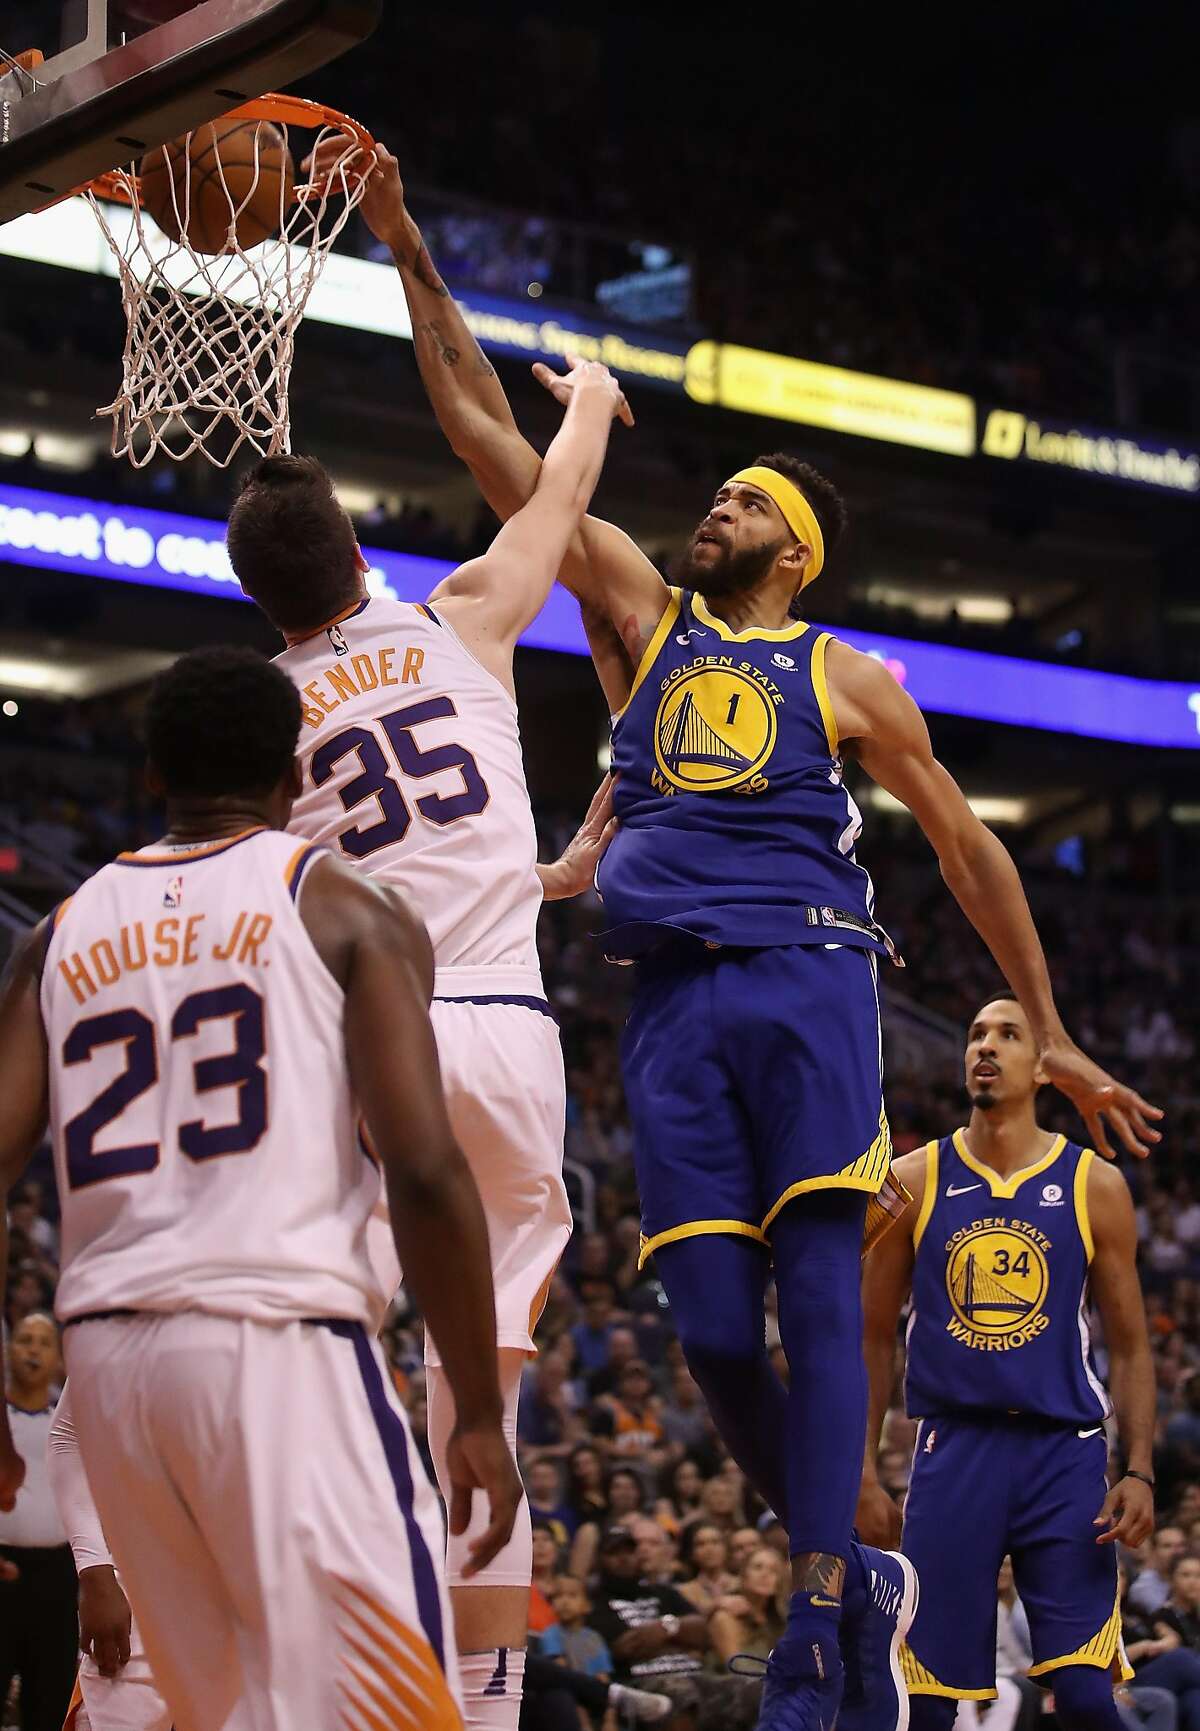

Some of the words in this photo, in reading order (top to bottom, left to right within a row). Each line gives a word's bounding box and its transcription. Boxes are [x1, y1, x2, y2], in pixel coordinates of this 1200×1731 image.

[103, 517, 154, 568] to
[302, 647, 425, 729] BENDER
[660, 655, 733, 691] GOLDEN
[738, 661, 785, 706] STATE
[726, 693, 741, 726] 1
[309, 695, 492, 860] 35
[58, 913, 205, 1005] HOUSE
[212, 911, 273, 968] JR.
[61, 981, 269, 1191] 23
[945, 1217, 1005, 1251] GOLDEN
[1010, 1219, 1053, 1252] STATE
[992, 1249, 1030, 1278] 34
[945, 1312, 1050, 1351] WARRIORS
